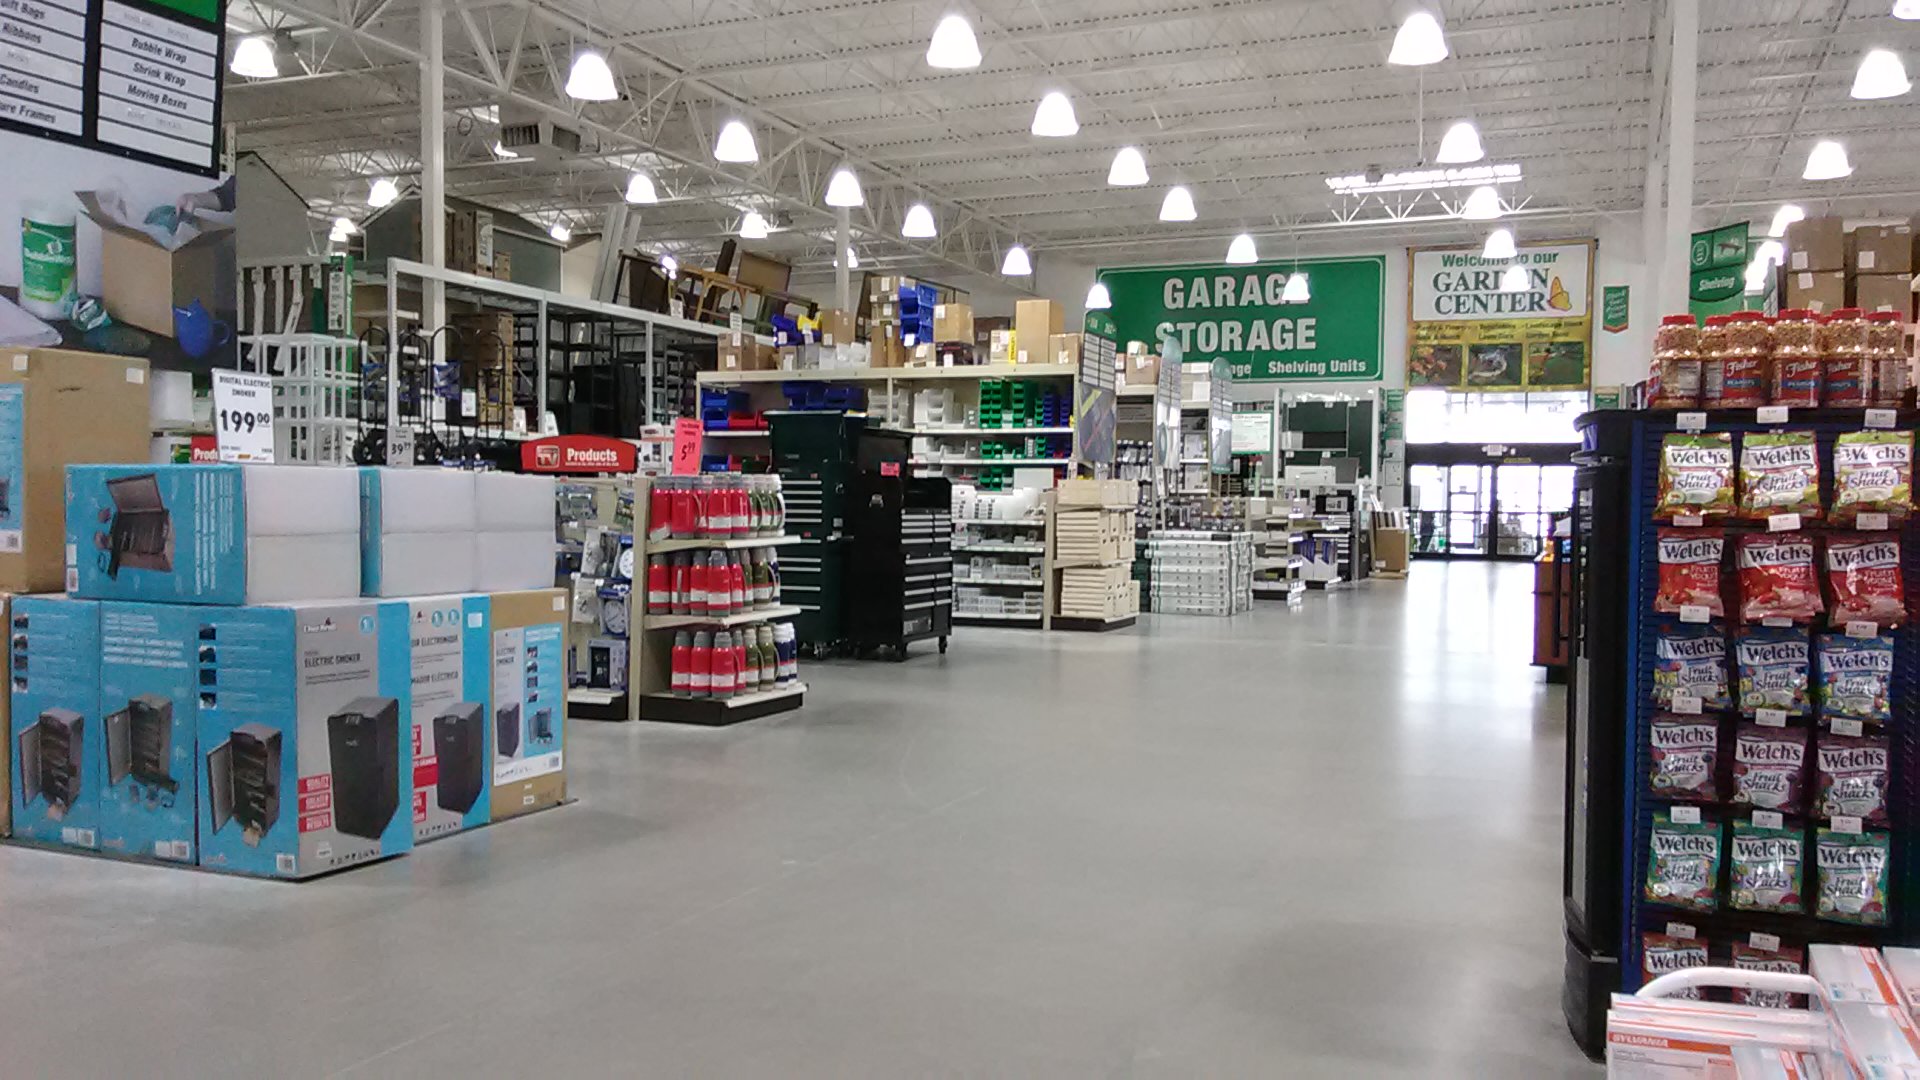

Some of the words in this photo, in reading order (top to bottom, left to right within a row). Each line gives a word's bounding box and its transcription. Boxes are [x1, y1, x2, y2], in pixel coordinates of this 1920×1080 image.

[21, 3, 45, 20] Bags
[2, 22, 42, 43] Ribbons
[131, 37, 162, 56] Bubble
[164, 47, 187, 64] Wrap
[0, 73, 39, 94] Candles
[132, 62, 161, 79] Shrink
[164, 71, 187, 87] Wrap
[127, 84, 160, 104] Moving
[161, 94, 188, 110] Boxes
[19, 105, 56, 124] Frames
[1441, 254, 1510, 268] Welcome
[1533, 252, 1560, 264] our
[1432, 268, 1550, 293] GARN
[1699, 276, 1736, 292] Shelving
[1434, 291, 1547, 315] CENTER
[1154, 317, 1317, 355] STORAGE
[1267, 359, 1327, 376] Shelving
[1330, 358, 1367, 373] Units
[1726, 359, 1758, 378] Fisher
[1785, 360, 1818, 378] Fisher
[219, 375, 242, 386] DIGITAL
[243, 378, 271, 389] ELECTRIC
[231, 388, 256, 398] SMOKER
[220, 408, 255, 434] 199
[193, 447, 218, 461] Prod
[566, 447, 618, 462] Products
[1671, 451, 1728, 464] Welch's
[1753, 447, 1812, 465] Welch's
[1845, 446, 1906, 461] Wech's
[1664, 540, 1721, 559] Welch's
[1749, 546, 1811, 563] Welch's
[1833, 544, 1897, 566] Welch's
[1669, 639, 1725, 657] Welch's
[1746, 643, 1806, 661] Welch's
[304, 655, 335, 668] ELECTRIC
[335, 653, 361, 665] SMOKER
[1828, 652, 1889, 669] Welch's
[1656, 727, 1714, 744] Welch's
[1740, 743, 1801, 761] Welch's
[1823, 750, 1884, 768] Welch's
[1657, 836, 1714, 853] Welch's
[1650, 949, 1707, 969] Welch's
[1612, 1033, 1669, 1048] SYLVANIA
